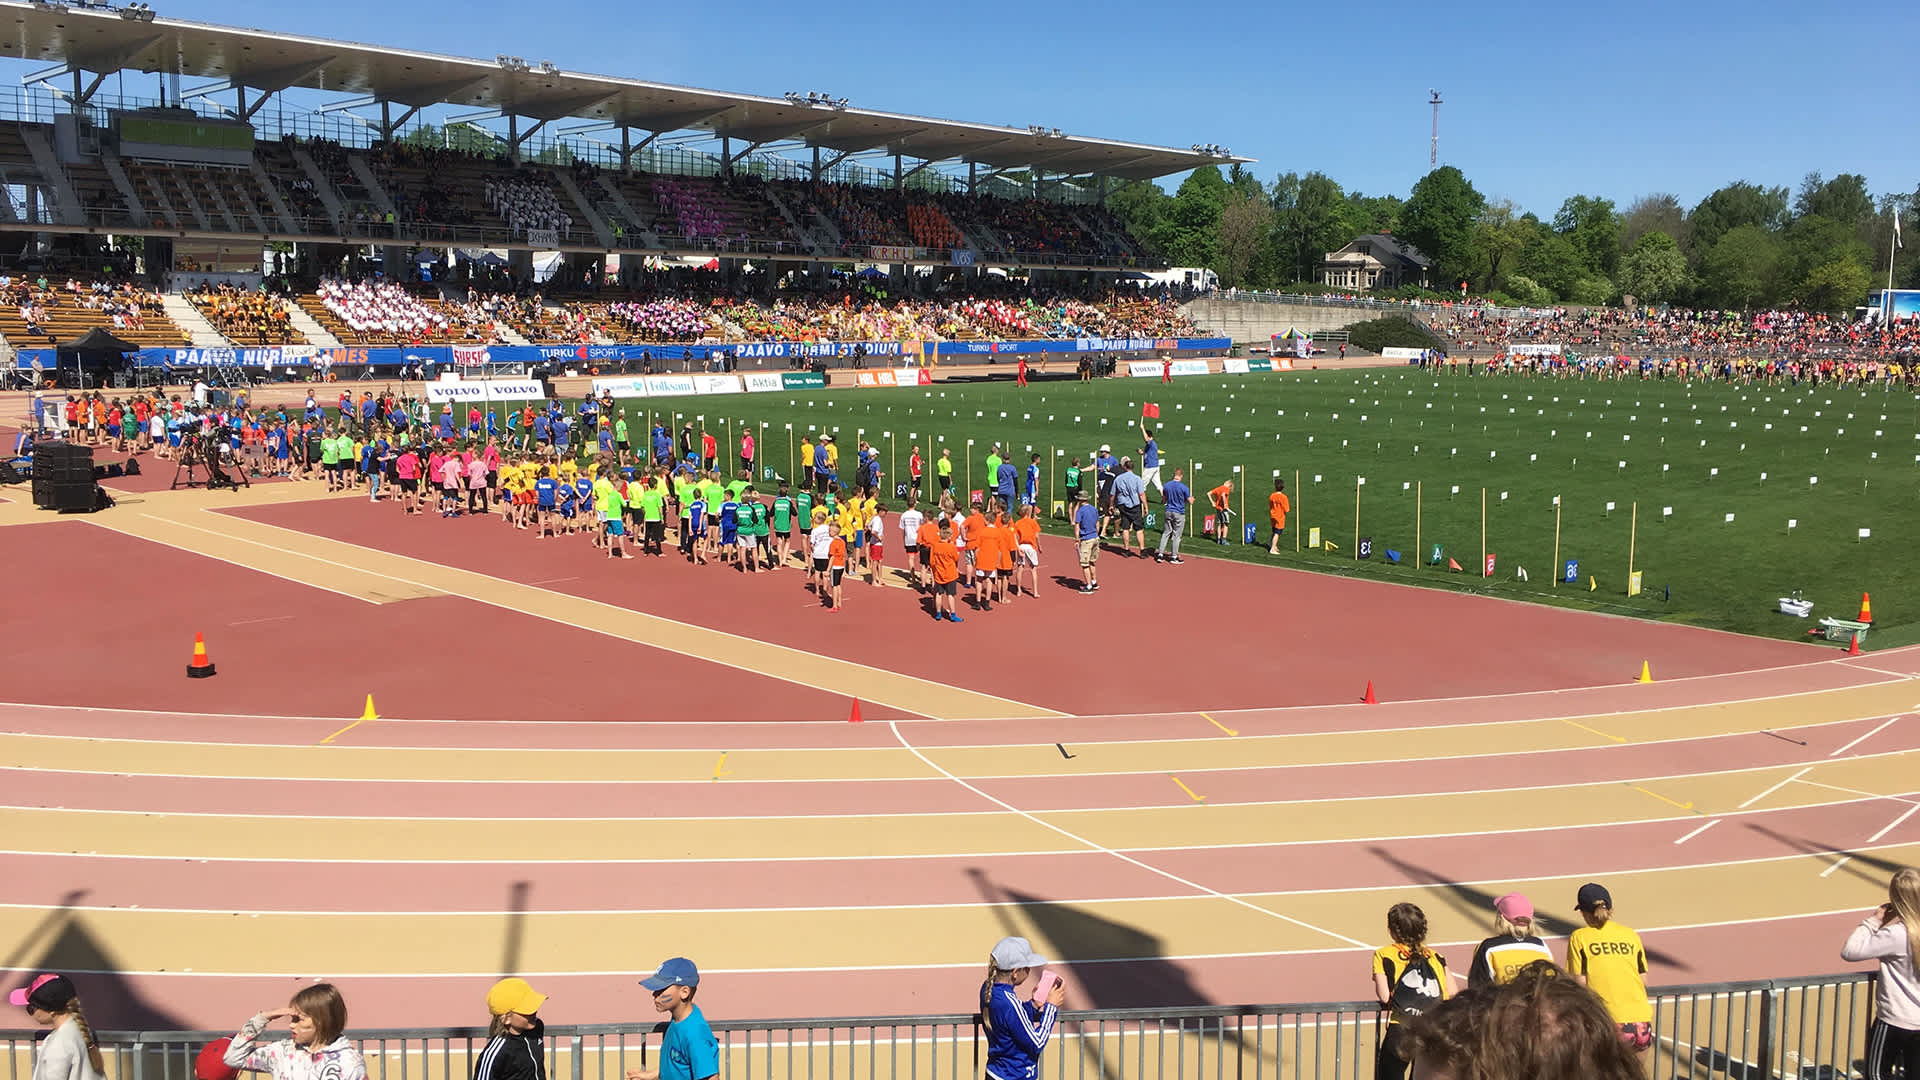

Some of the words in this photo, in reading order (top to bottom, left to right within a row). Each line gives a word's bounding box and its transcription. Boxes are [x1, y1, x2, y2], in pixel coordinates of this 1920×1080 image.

[737, 344, 784, 357] PAAVO
[968, 344, 990, 352] TURKU
[998, 343, 1018, 352] SPORT
[1103, 339, 1127, 351] PAAVO
[1129, 339, 1153, 350] NURMI
[1154, 338, 1179, 350] GAMES
[540, 348, 574, 358] TURKU
[590, 347, 618, 358] SPORT
[752, 378, 777, 388] Aktia
[858, 373, 877, 385] HBL
[877, 372, 896, 384] HBL
[434, 387, 480, 396] VOLVO
[493, 385, 538, 394] VOLVO
[649, 380, 691, 393] Folksam
[1588, 941, 1635, 956] GERBY
